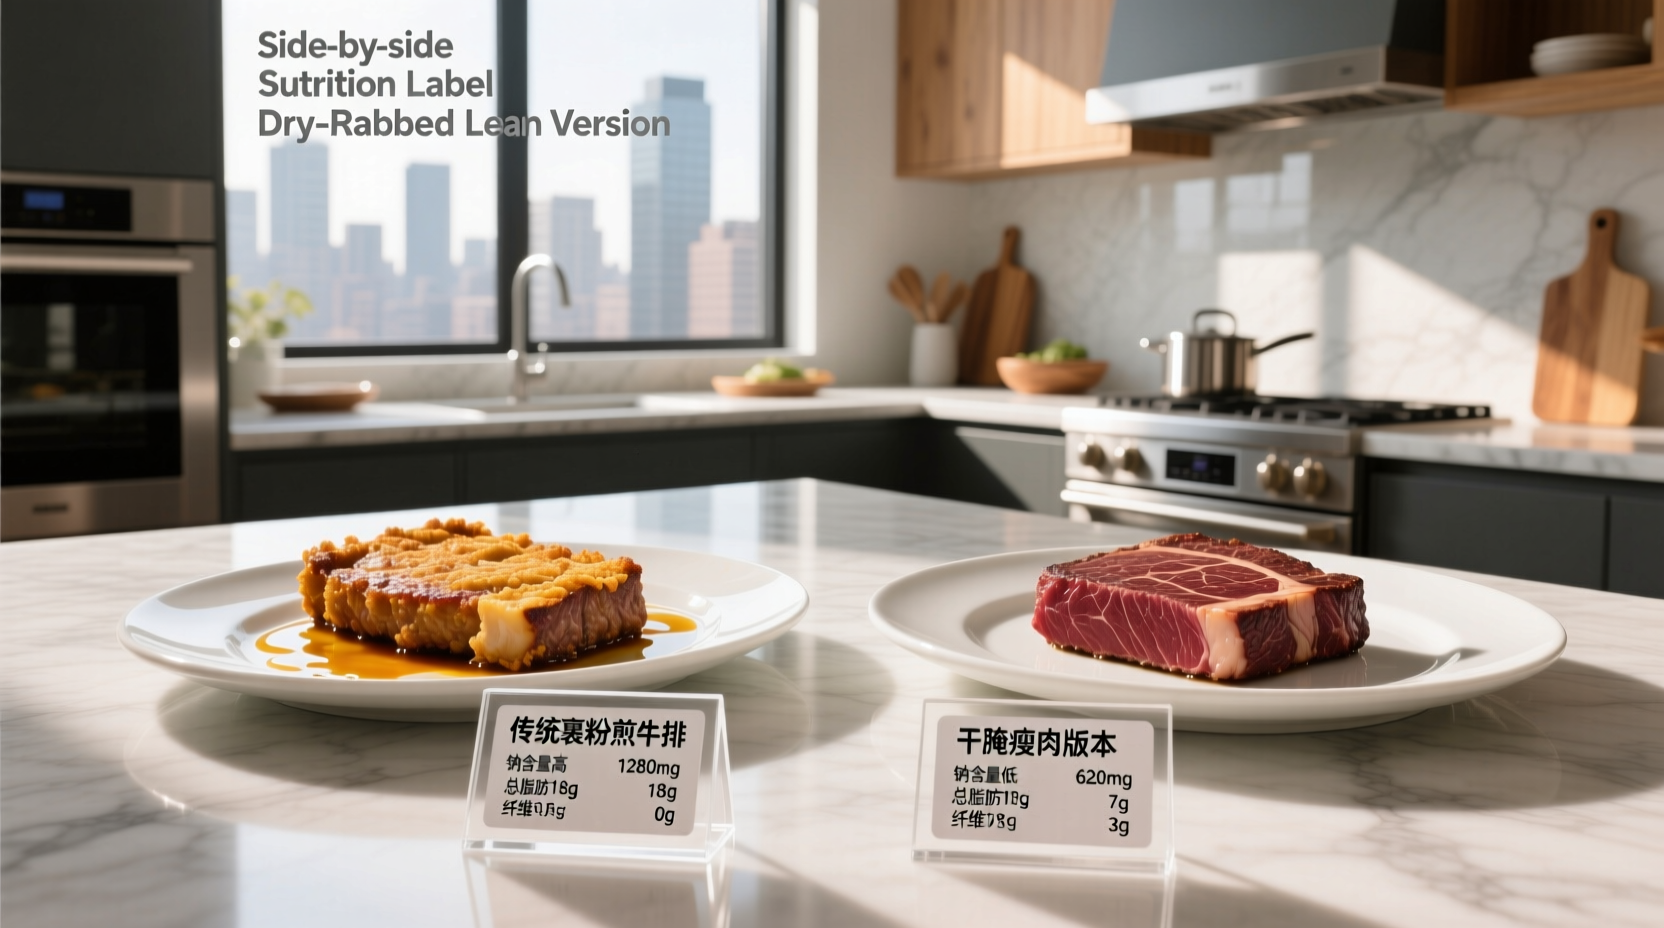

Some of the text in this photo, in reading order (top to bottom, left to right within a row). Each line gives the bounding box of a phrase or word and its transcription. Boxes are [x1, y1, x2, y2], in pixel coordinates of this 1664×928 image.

[957, 727, 1117, 758] 干腌瘦肉版本
[619, 759, 680, 779] 1280mg
[1076, 769, 1132, 790] 620mg
[649, 783, 677, 802] 18g
[1109, 795, 1128, 814] 7g
[655, 806, 675, 826] 0g
[1109, 817, 1129, 837] 3g
